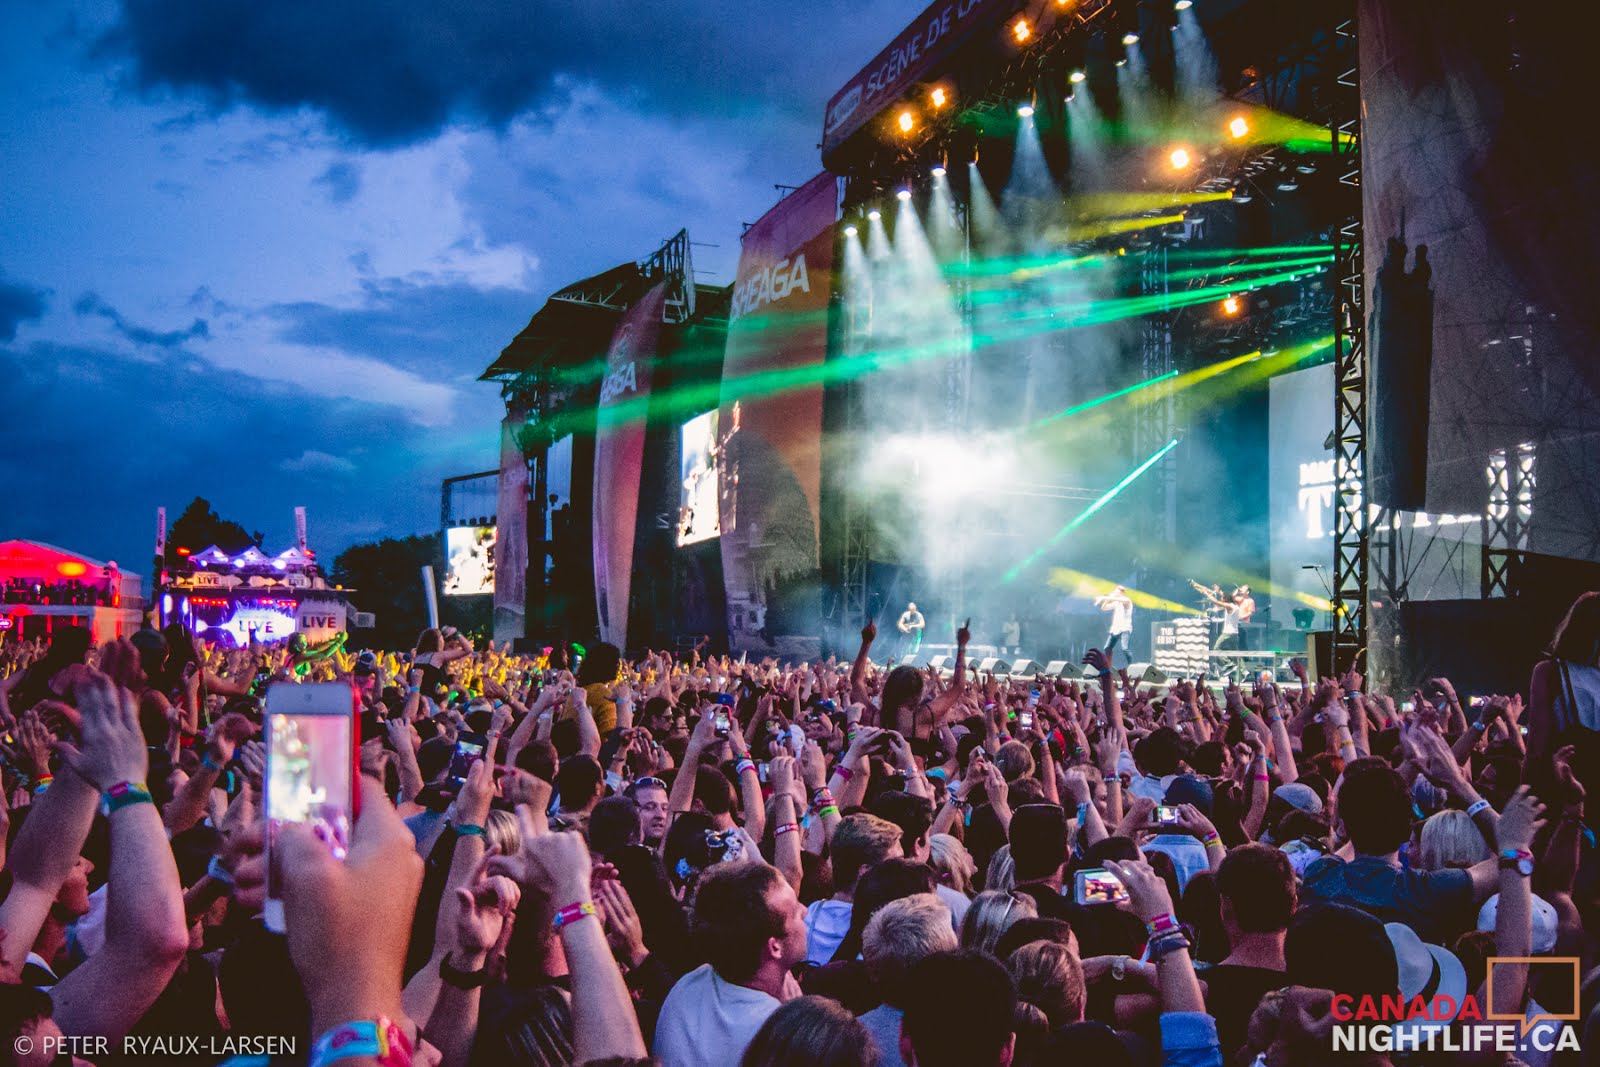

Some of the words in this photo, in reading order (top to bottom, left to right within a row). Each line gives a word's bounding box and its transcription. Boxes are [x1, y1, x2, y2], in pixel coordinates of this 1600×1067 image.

[866, 32, 922, 99] SCÈNE
[925, 4, 953, 48] DE
[198, 576, 219, 585] LIVE
[239, 620, 274, 634] LIVE
[302, 616, 336, 629] LIVE
